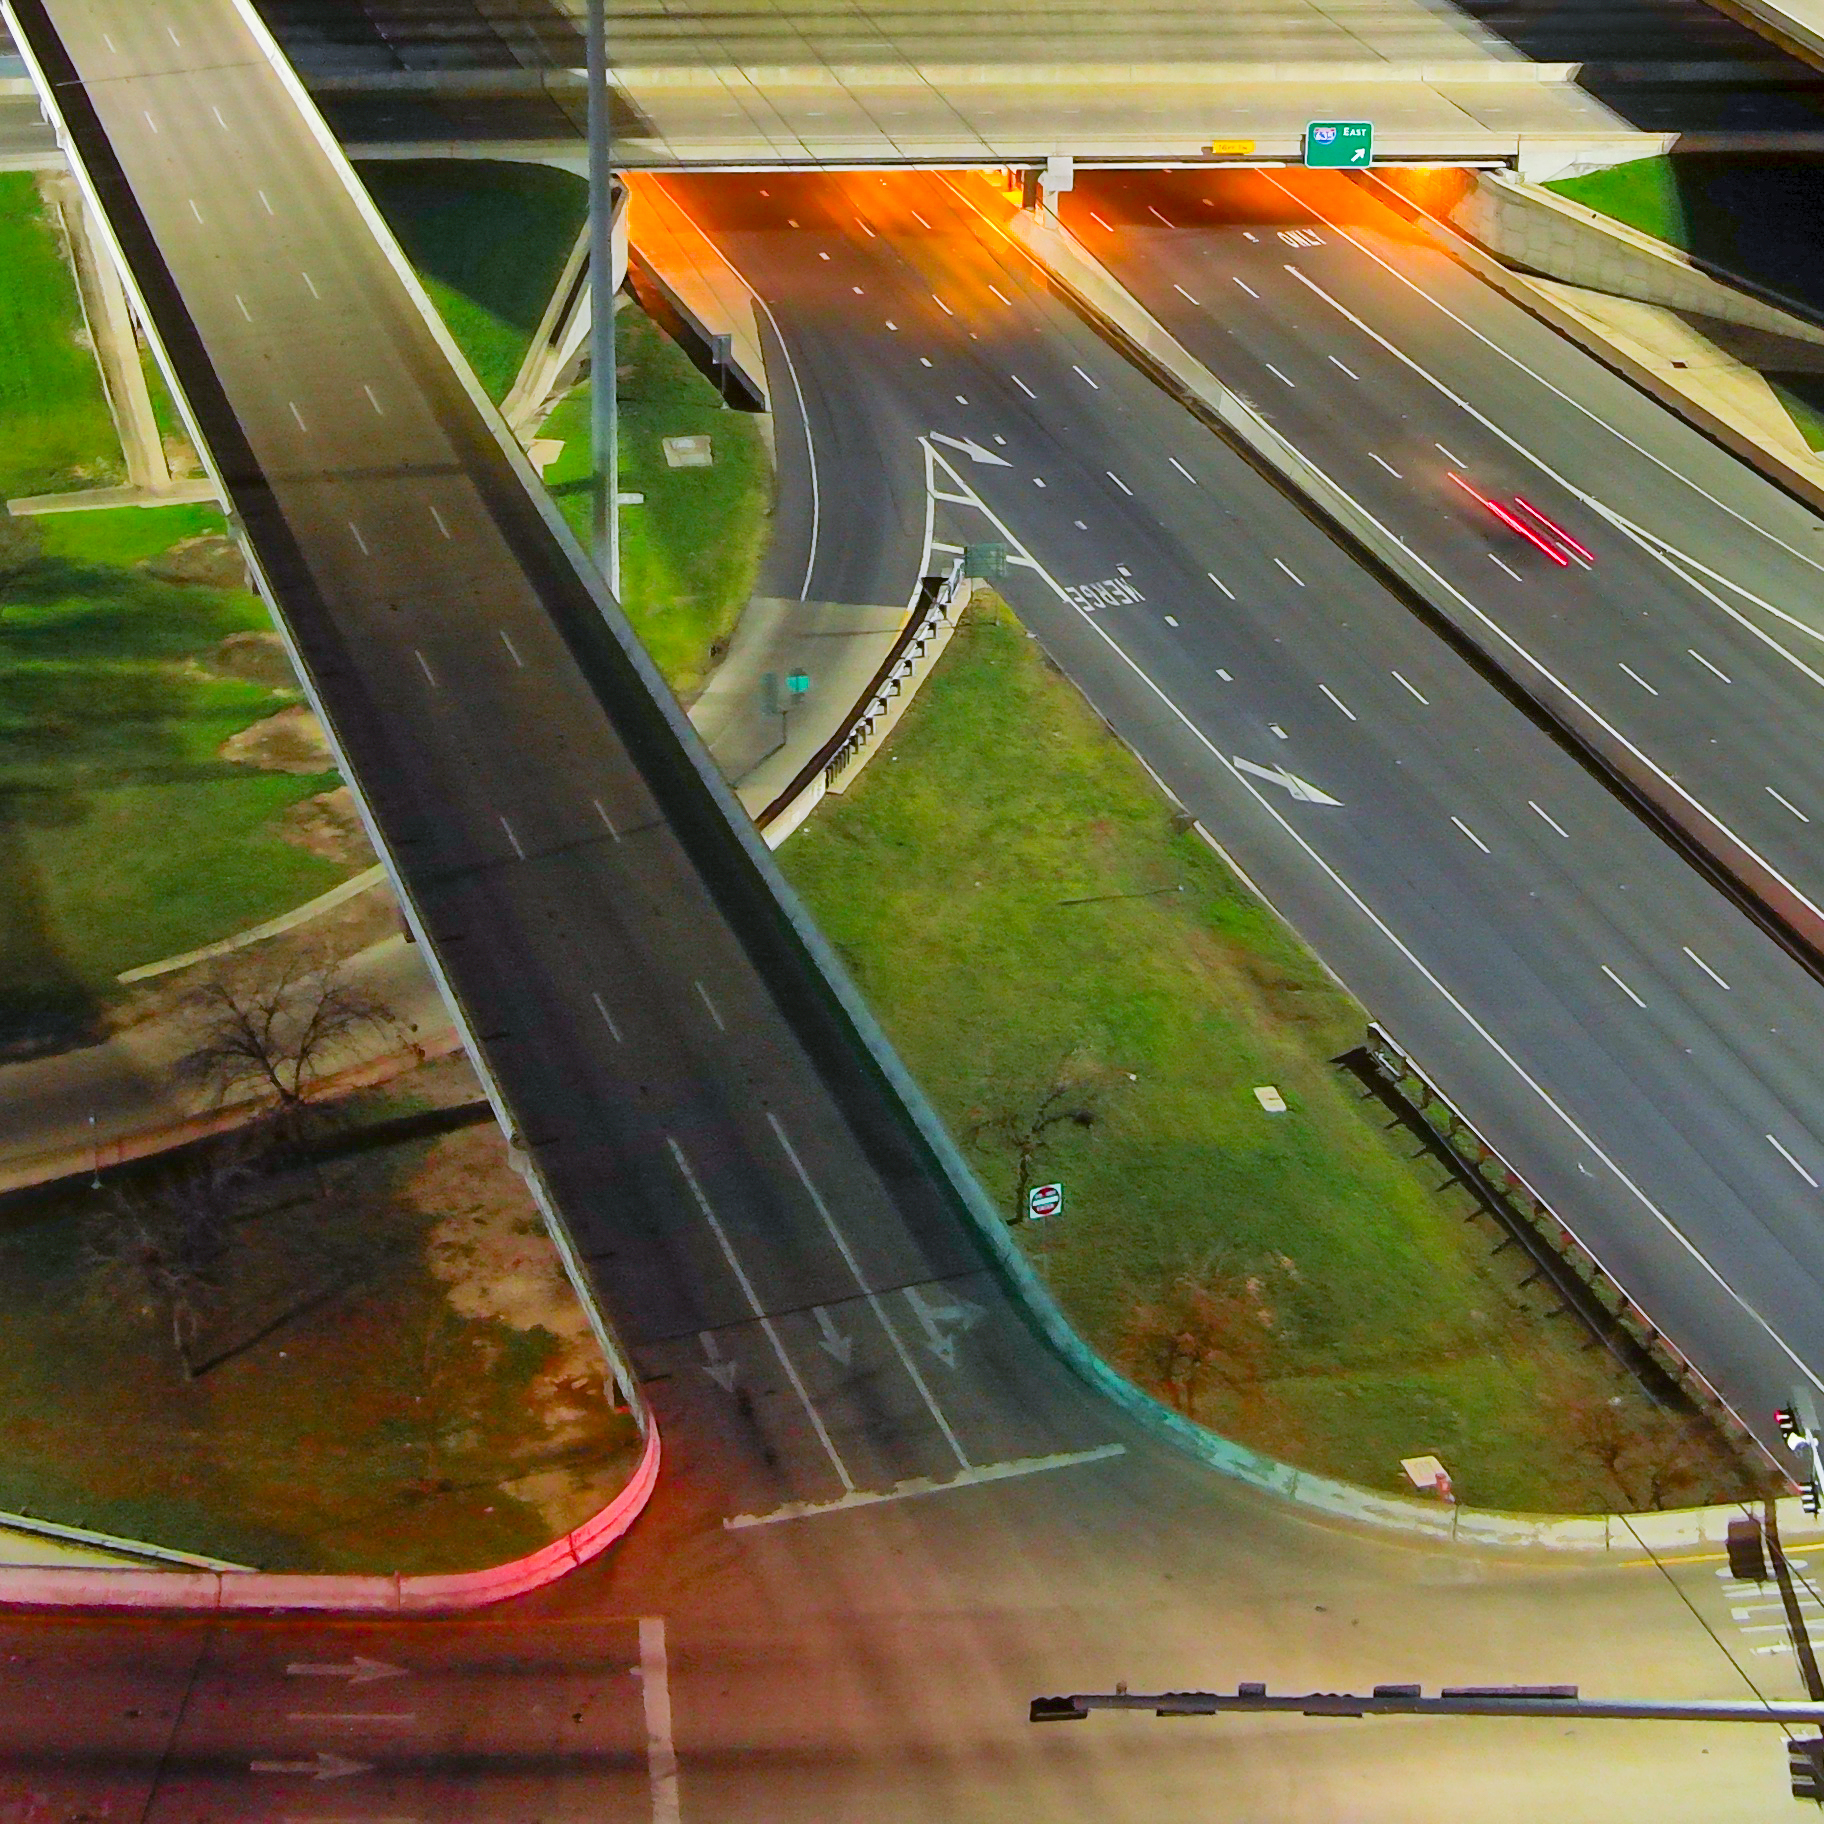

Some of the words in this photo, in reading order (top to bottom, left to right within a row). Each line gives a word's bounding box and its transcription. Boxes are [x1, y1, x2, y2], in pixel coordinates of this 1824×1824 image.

[1343, 127, 1366, 136] EAST
[1276, 229, 1327, 249] ONLY
[1064, 576, 1146, 612] MERGE
